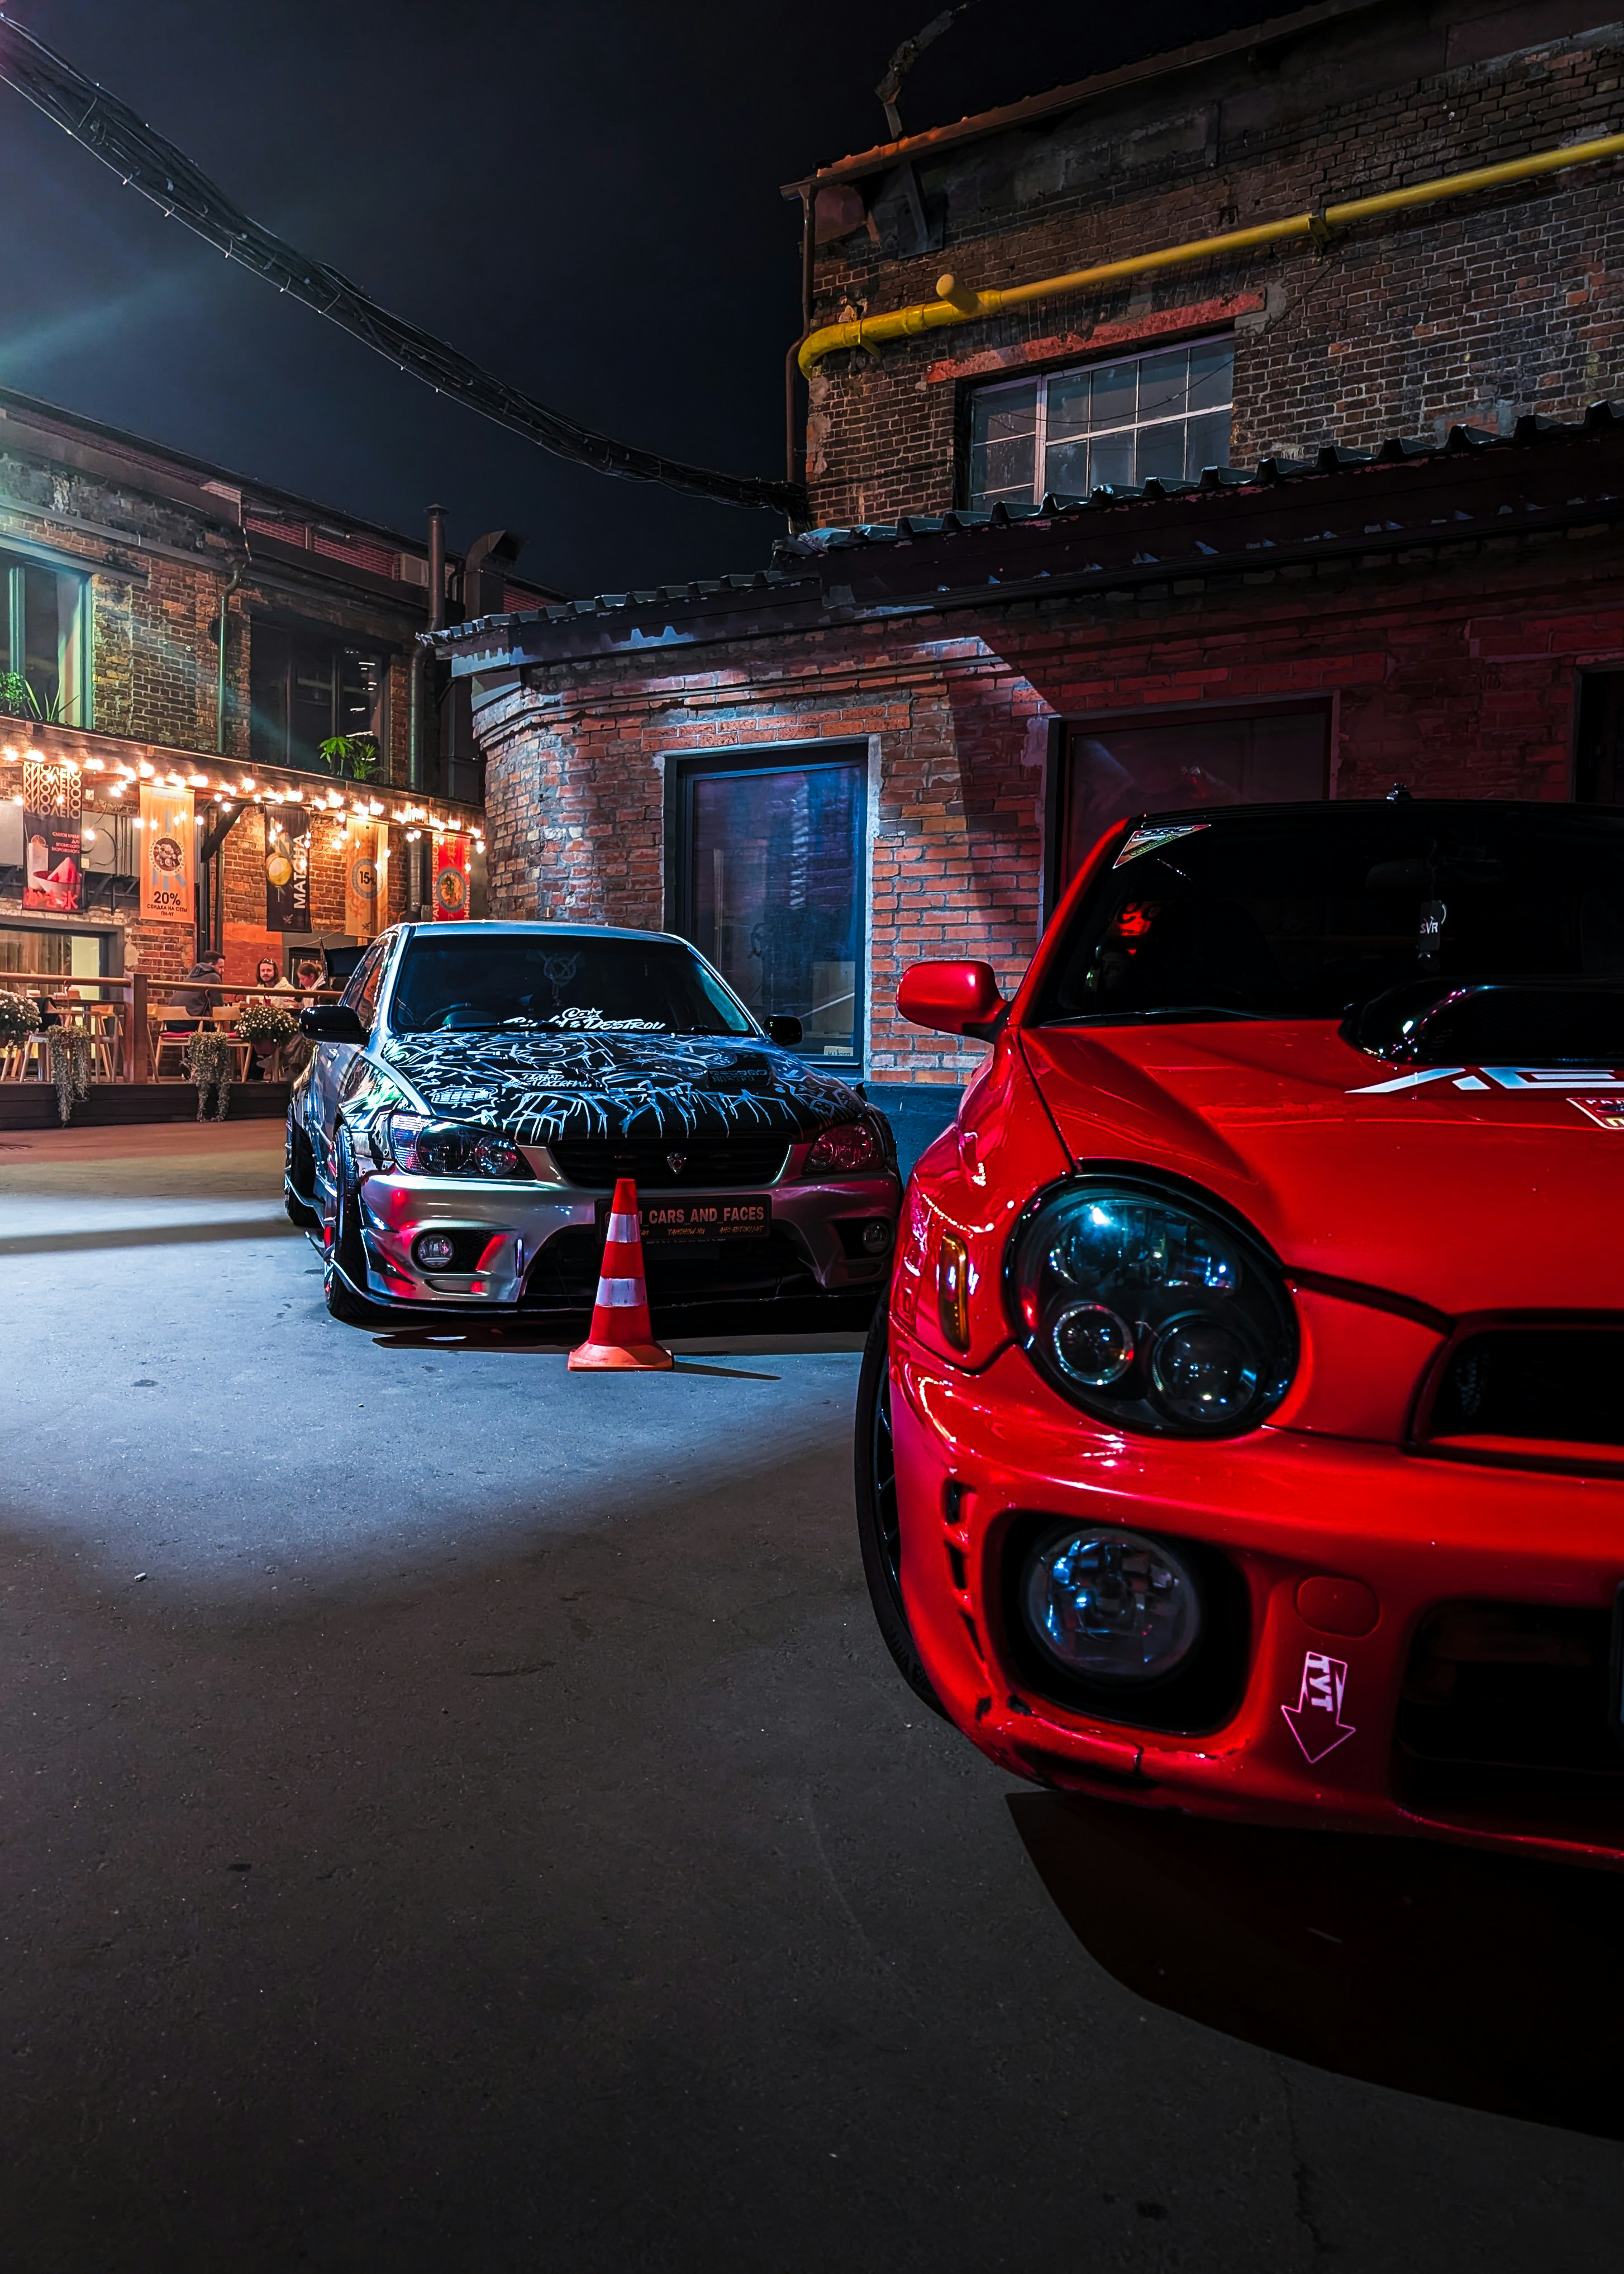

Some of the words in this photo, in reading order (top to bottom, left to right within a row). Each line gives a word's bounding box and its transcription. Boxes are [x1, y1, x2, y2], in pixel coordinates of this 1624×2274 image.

[293, 834, 307, 909] MATCHA
[359, 870, 377, 886] 15%
[154, 891, 181, 906] 20%
